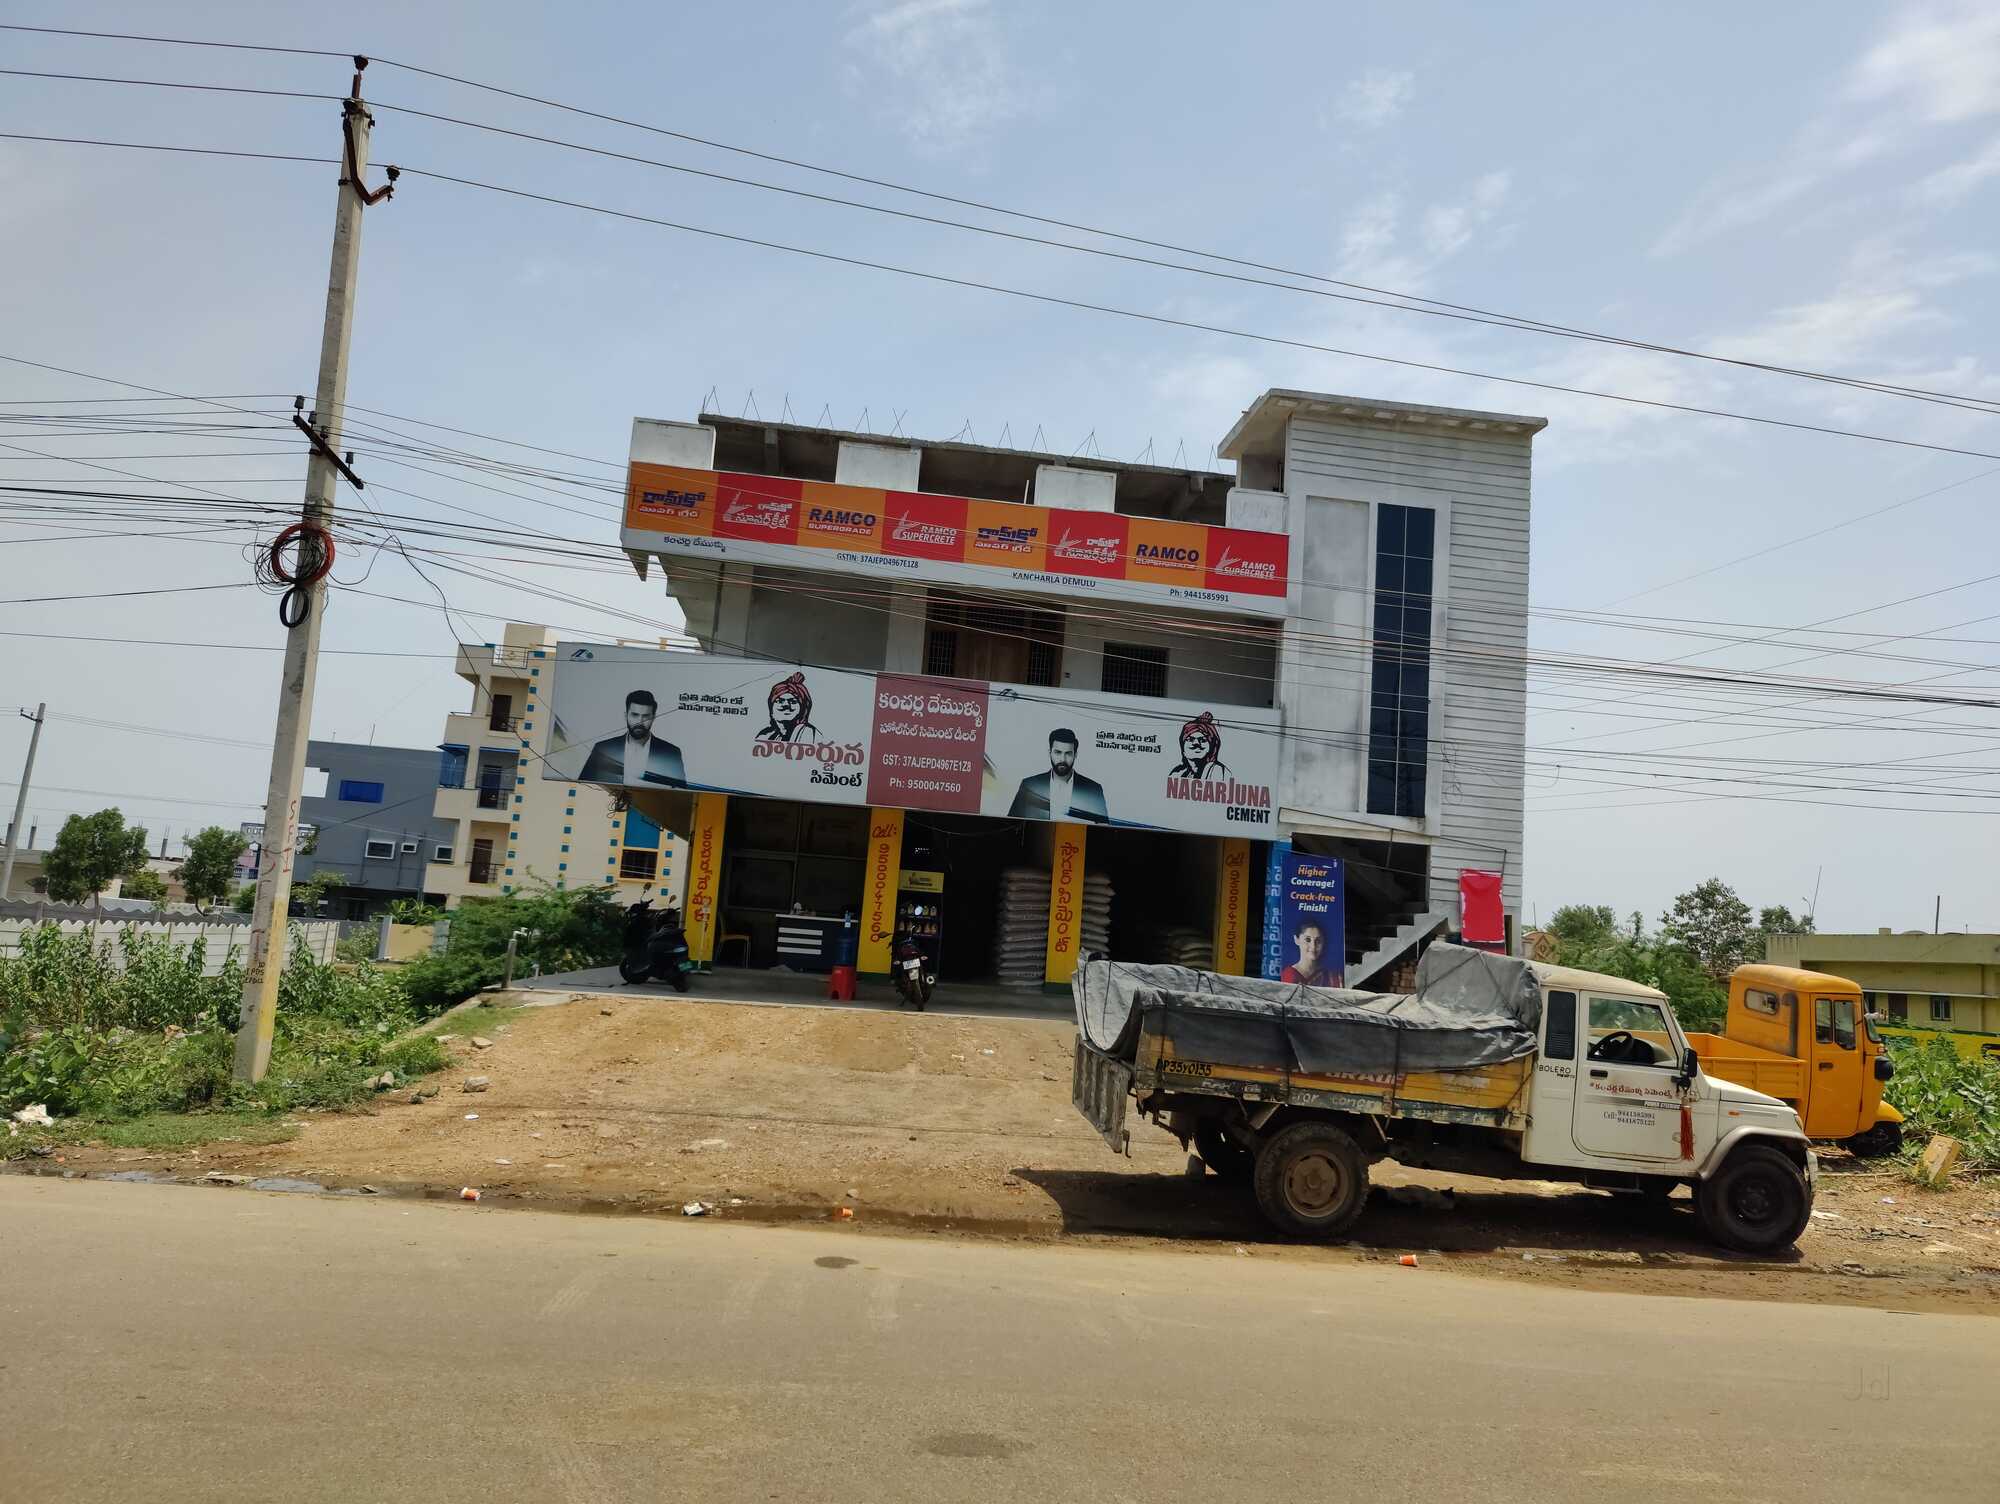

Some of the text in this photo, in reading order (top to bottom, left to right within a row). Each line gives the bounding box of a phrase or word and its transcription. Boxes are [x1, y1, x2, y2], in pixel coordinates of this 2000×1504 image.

[809, 508, 877, 527] RAMCO
[808, 522, 873, 536] SUPERGRADE
[920, 525, 958, 536] RAMCO
[902, 531, 956, 545] SUPERCRETE
[1135, 544, 1200, 562] RAMCO
[1223, 566, 1275, 580] SUPERCRETE
[1241, 561, 1276, 571] RAMCO
[1012, 571, 1096, 588] KANCHARLA DEMULU
[1170, 588, 1230, 602] Ph: 9441585991
[879, 692, 924, 717] కంచర్ల
[919, 726, 954, 740] సిమెంట్
[752, 740, 865, 771] నాగార్జున
[882, 754, 972, 772] GST: 37AJEPD4967E1Z8
[810, 769, 864, 787] సిమెంట్
[889, 777, 961, 792] Ph: 9500047560
[1166, 776, 1271, 808] NAGARJUNA
[1226, 806, 1271, 824] CEMENT
[1297, 866, 1328, 877] Higher
[1290, 876, 1335, 889] Coverage!
[1290, 891, 1336, 902] Crack-free
[1298, 902, 1328, 912] Finish!
[1538, 1064, 1572, 1074] BOLERO
